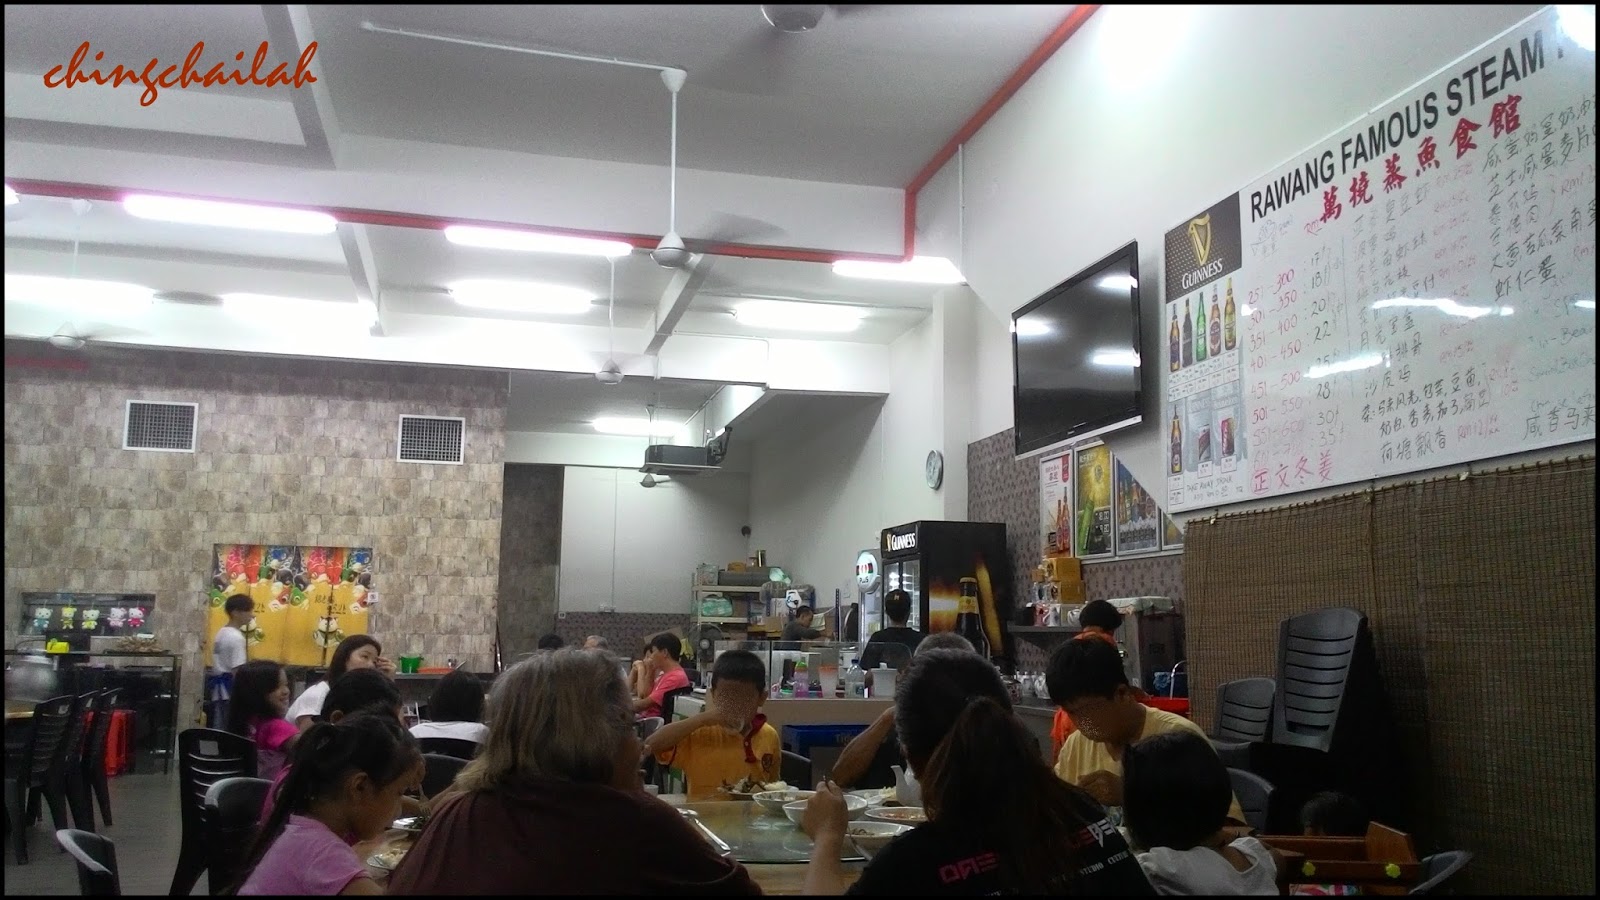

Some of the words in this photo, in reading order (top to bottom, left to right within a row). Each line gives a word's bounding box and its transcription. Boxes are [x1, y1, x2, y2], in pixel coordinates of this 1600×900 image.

[1251, 149, 1335, 223] RAWANG
[1341, 92, 1439, 175] FAMOUS
[1446, 30, 1544, 116] STEAM
[1182, 258, 1223, 290] GUINNESS
[891, 532, 916, 551] GUINNESS
